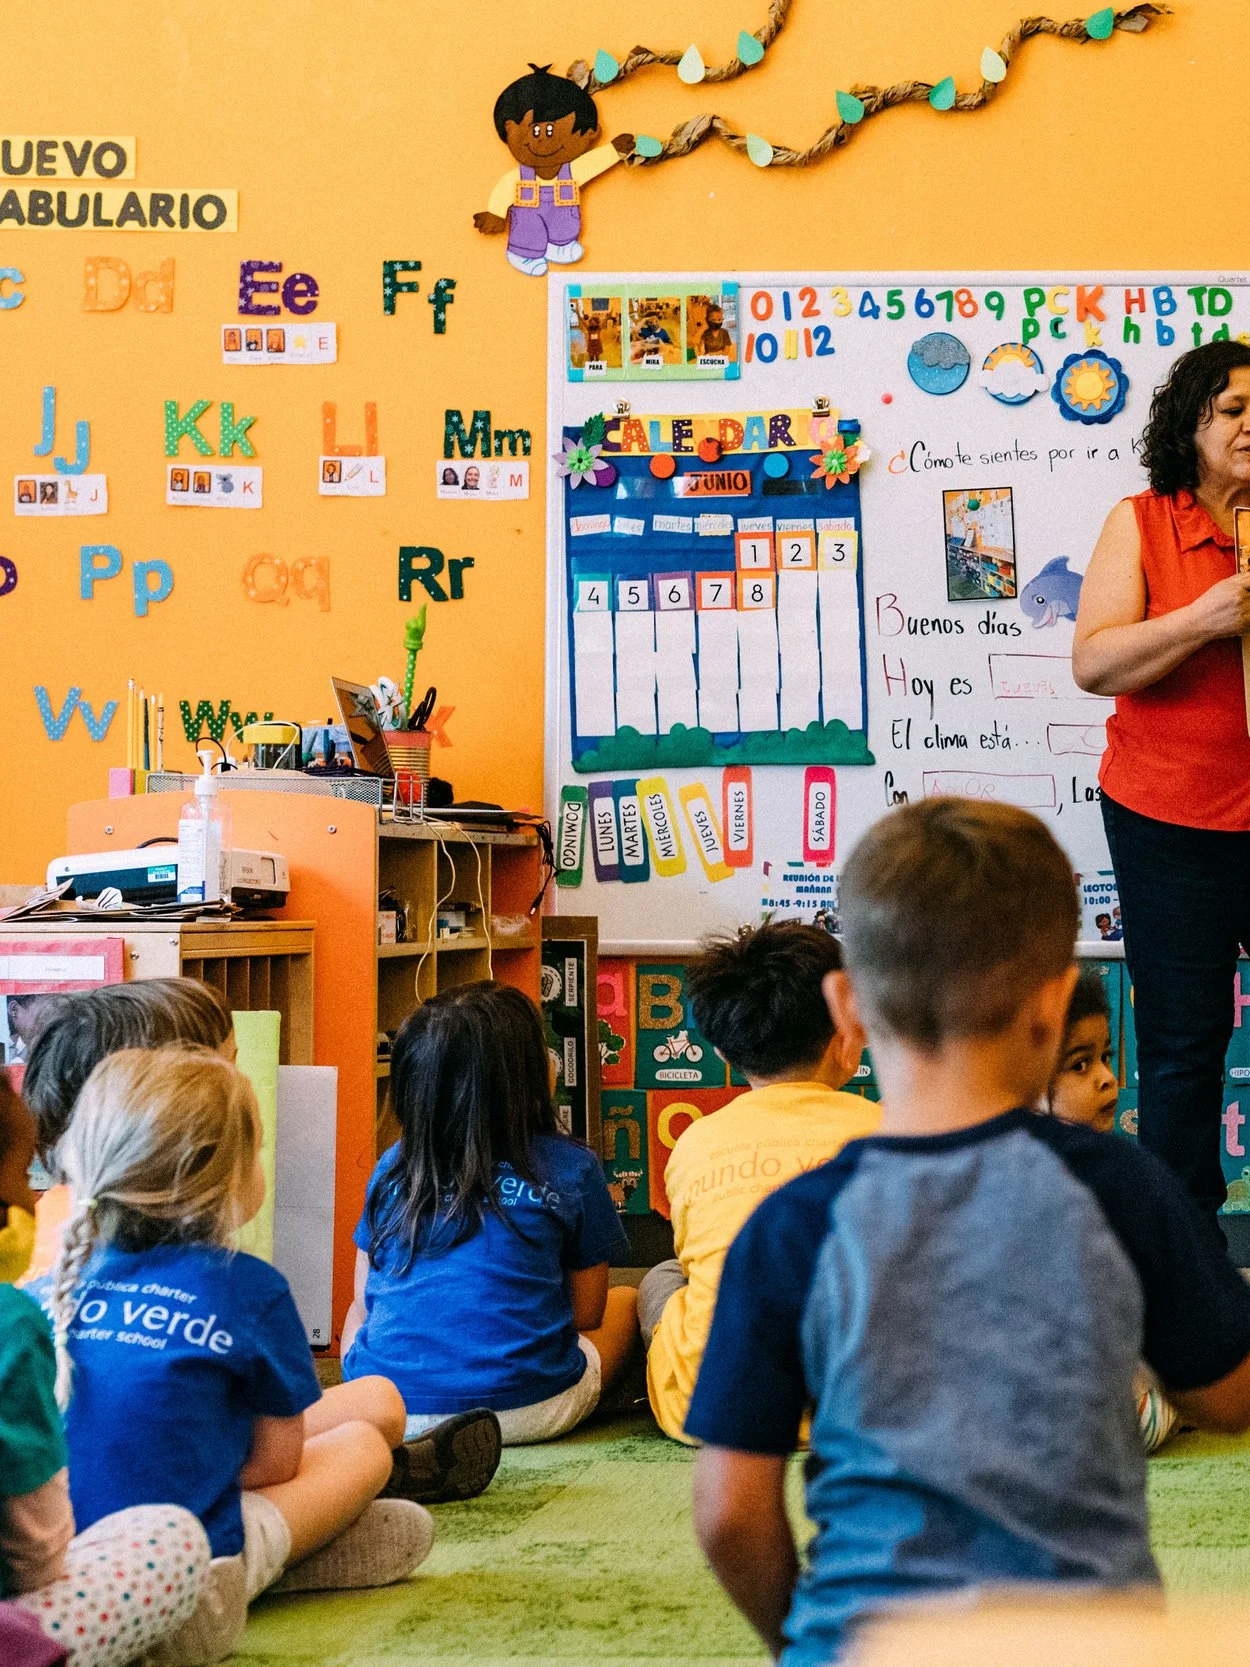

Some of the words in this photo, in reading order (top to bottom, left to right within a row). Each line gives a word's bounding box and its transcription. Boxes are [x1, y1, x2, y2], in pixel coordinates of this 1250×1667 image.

[1, 140, 128, 179] UEVO
[0, 190, 227, 230] ABULARIO
[700, 358, 725, 366] ESCUCHA
[956, 442, 973, 465] te
[979, 440, 1038, 465] sientes
[1048, 448, 1075, 472] por
[1086, 446, 1098, 460] ir
[1107, 448, 1120, 460] a
[690, 472, 748, 492] JUNIO
[654, 520, 691, 533] martes
[751, 545, 757, 562] 1
[791, 544, 802, 562] 2
[832, 543, 845, 562] 3
[588, 587, 599, 605] 4
[628, 586, 640, 605] 5
[669, 585, 681, 603] 6
[710, 584, 722, 602] 7
[752, 584, 763, 602] 8
[876, 593, 964, 636] Buenos
[978, 610, 1022, 637] días
[882, 653, 934, 720] Hoy
[950, 676, 972, 695] es
[891, 718, 911, 750] El
[924, 724, 968, 750] clima
[598, 811, 615, 852] LUNES
[623, 803, 640, 858] MARTES
[652, 793, 676, 858] MIÉRCOLES
[697, 810, 719, 853] JUEVES
[733, 790, 744, 843] VIERNES
[813, 791, 826, 842] SÁBADO
[563, 802, 581, 866] DOMINGO
[783, 873, 820, 882] REUNIÓN
[796, 884, 832, 893] MAÑANA
[768, 899, 790, 908] 8:45
[659, 1071, 699, 1080] BICICLETA
[141, 1283, 198, 1304] charter
[116, 1330, 167, 1351] school
[123, 1300, 234, 1354] verde
[312, 1328, 321, 1339] 28
